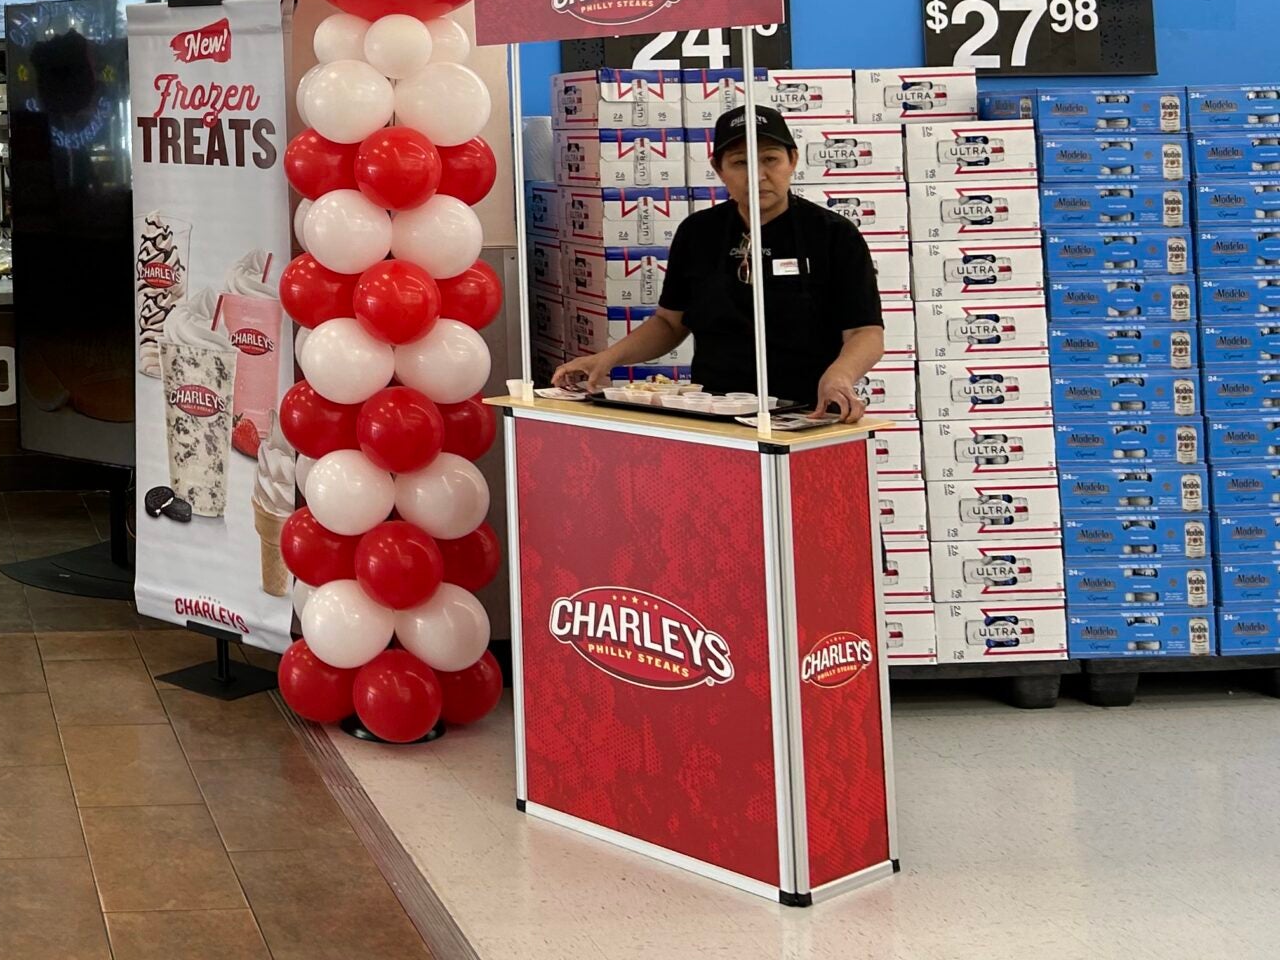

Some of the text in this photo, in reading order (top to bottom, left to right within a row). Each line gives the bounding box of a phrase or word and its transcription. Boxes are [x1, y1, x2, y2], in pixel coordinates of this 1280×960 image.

[580, 0, 654, 13] PHILLY STEAKS
[184, 28, 228, 61] New!
[153, 74, 260, 127] Frozen
[770, 94, 807, 102] ULTRA
[896, 92, 931, 101] ULTRA
[1055, 103, 1084, 113] Modelo
[1203, 101, 1234, 110] Modelo
[137, 117, 277, 170] TREATS
[819, 150, 856, 158] ULTRA
[950, 147, 987, 156] ULTRA
[1060, 150, 1088, 159] Modelo
[1213, 195, 1242, 204] Modelo
[953, 206, 991, 215] ULTRA
[1063, 245, 1091, 255] Modelo
[139, 266, 181, 284] CHARLEYS
[957, 265, 995, 275] ULTRA
[960, 325, 998, 334] ULTRA
[230, 332, 275, 351] CHARLEYS
[1065, 339, 1095, 349] Modelo
[964, 385, 1002, 395] ULTRA
[1221, 384, 1250, 393] Modelo
[170, 390, 225, 412] CHARLEYS
[1071, 434, 1100, 444] Modelo
[968, 446, 1007, 455] ULTRA
[1231, 479, 1260, 488] Modelo
[972, 506, 1011, 515] ULTRA
[1079, 530, 1109, 540] Modelo
[976, 567, 1015, 576] ULTRA
[1237, 574, 1266, 584] Modelo
[175, 597, 250, 634] CHARLEYS
[979, 627, 1018, 637] ULTRA
[1084, 627, 1114, 636] Modelo
[552, 600, 732, 678] CHARLEYS
[588, 643, 690, 678] PHILLY STEAKS
[802, 640, 873, 680] CHARLEYS
